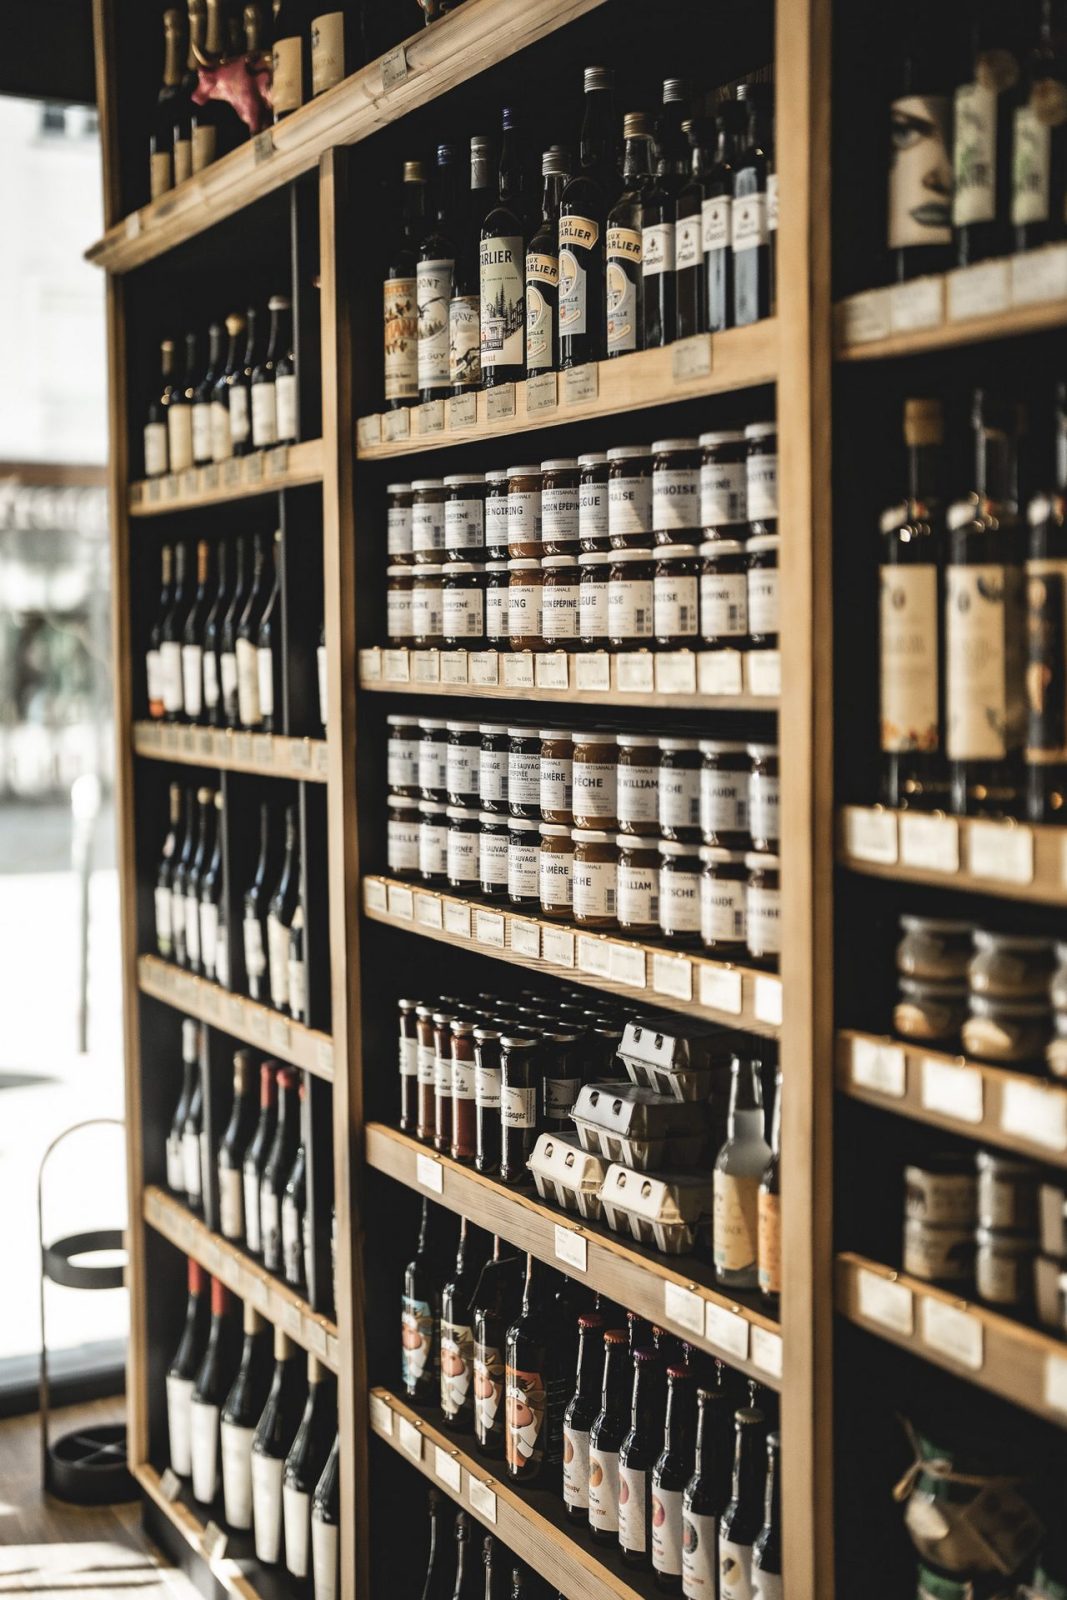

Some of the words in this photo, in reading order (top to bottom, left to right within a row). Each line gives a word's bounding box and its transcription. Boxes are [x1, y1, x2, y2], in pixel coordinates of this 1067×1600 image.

[607, 239, 641, 254] ARLIER
[526, 262, 557, 277] ARLIER
[559, 500, 580, 511] ÉPÉPIN
